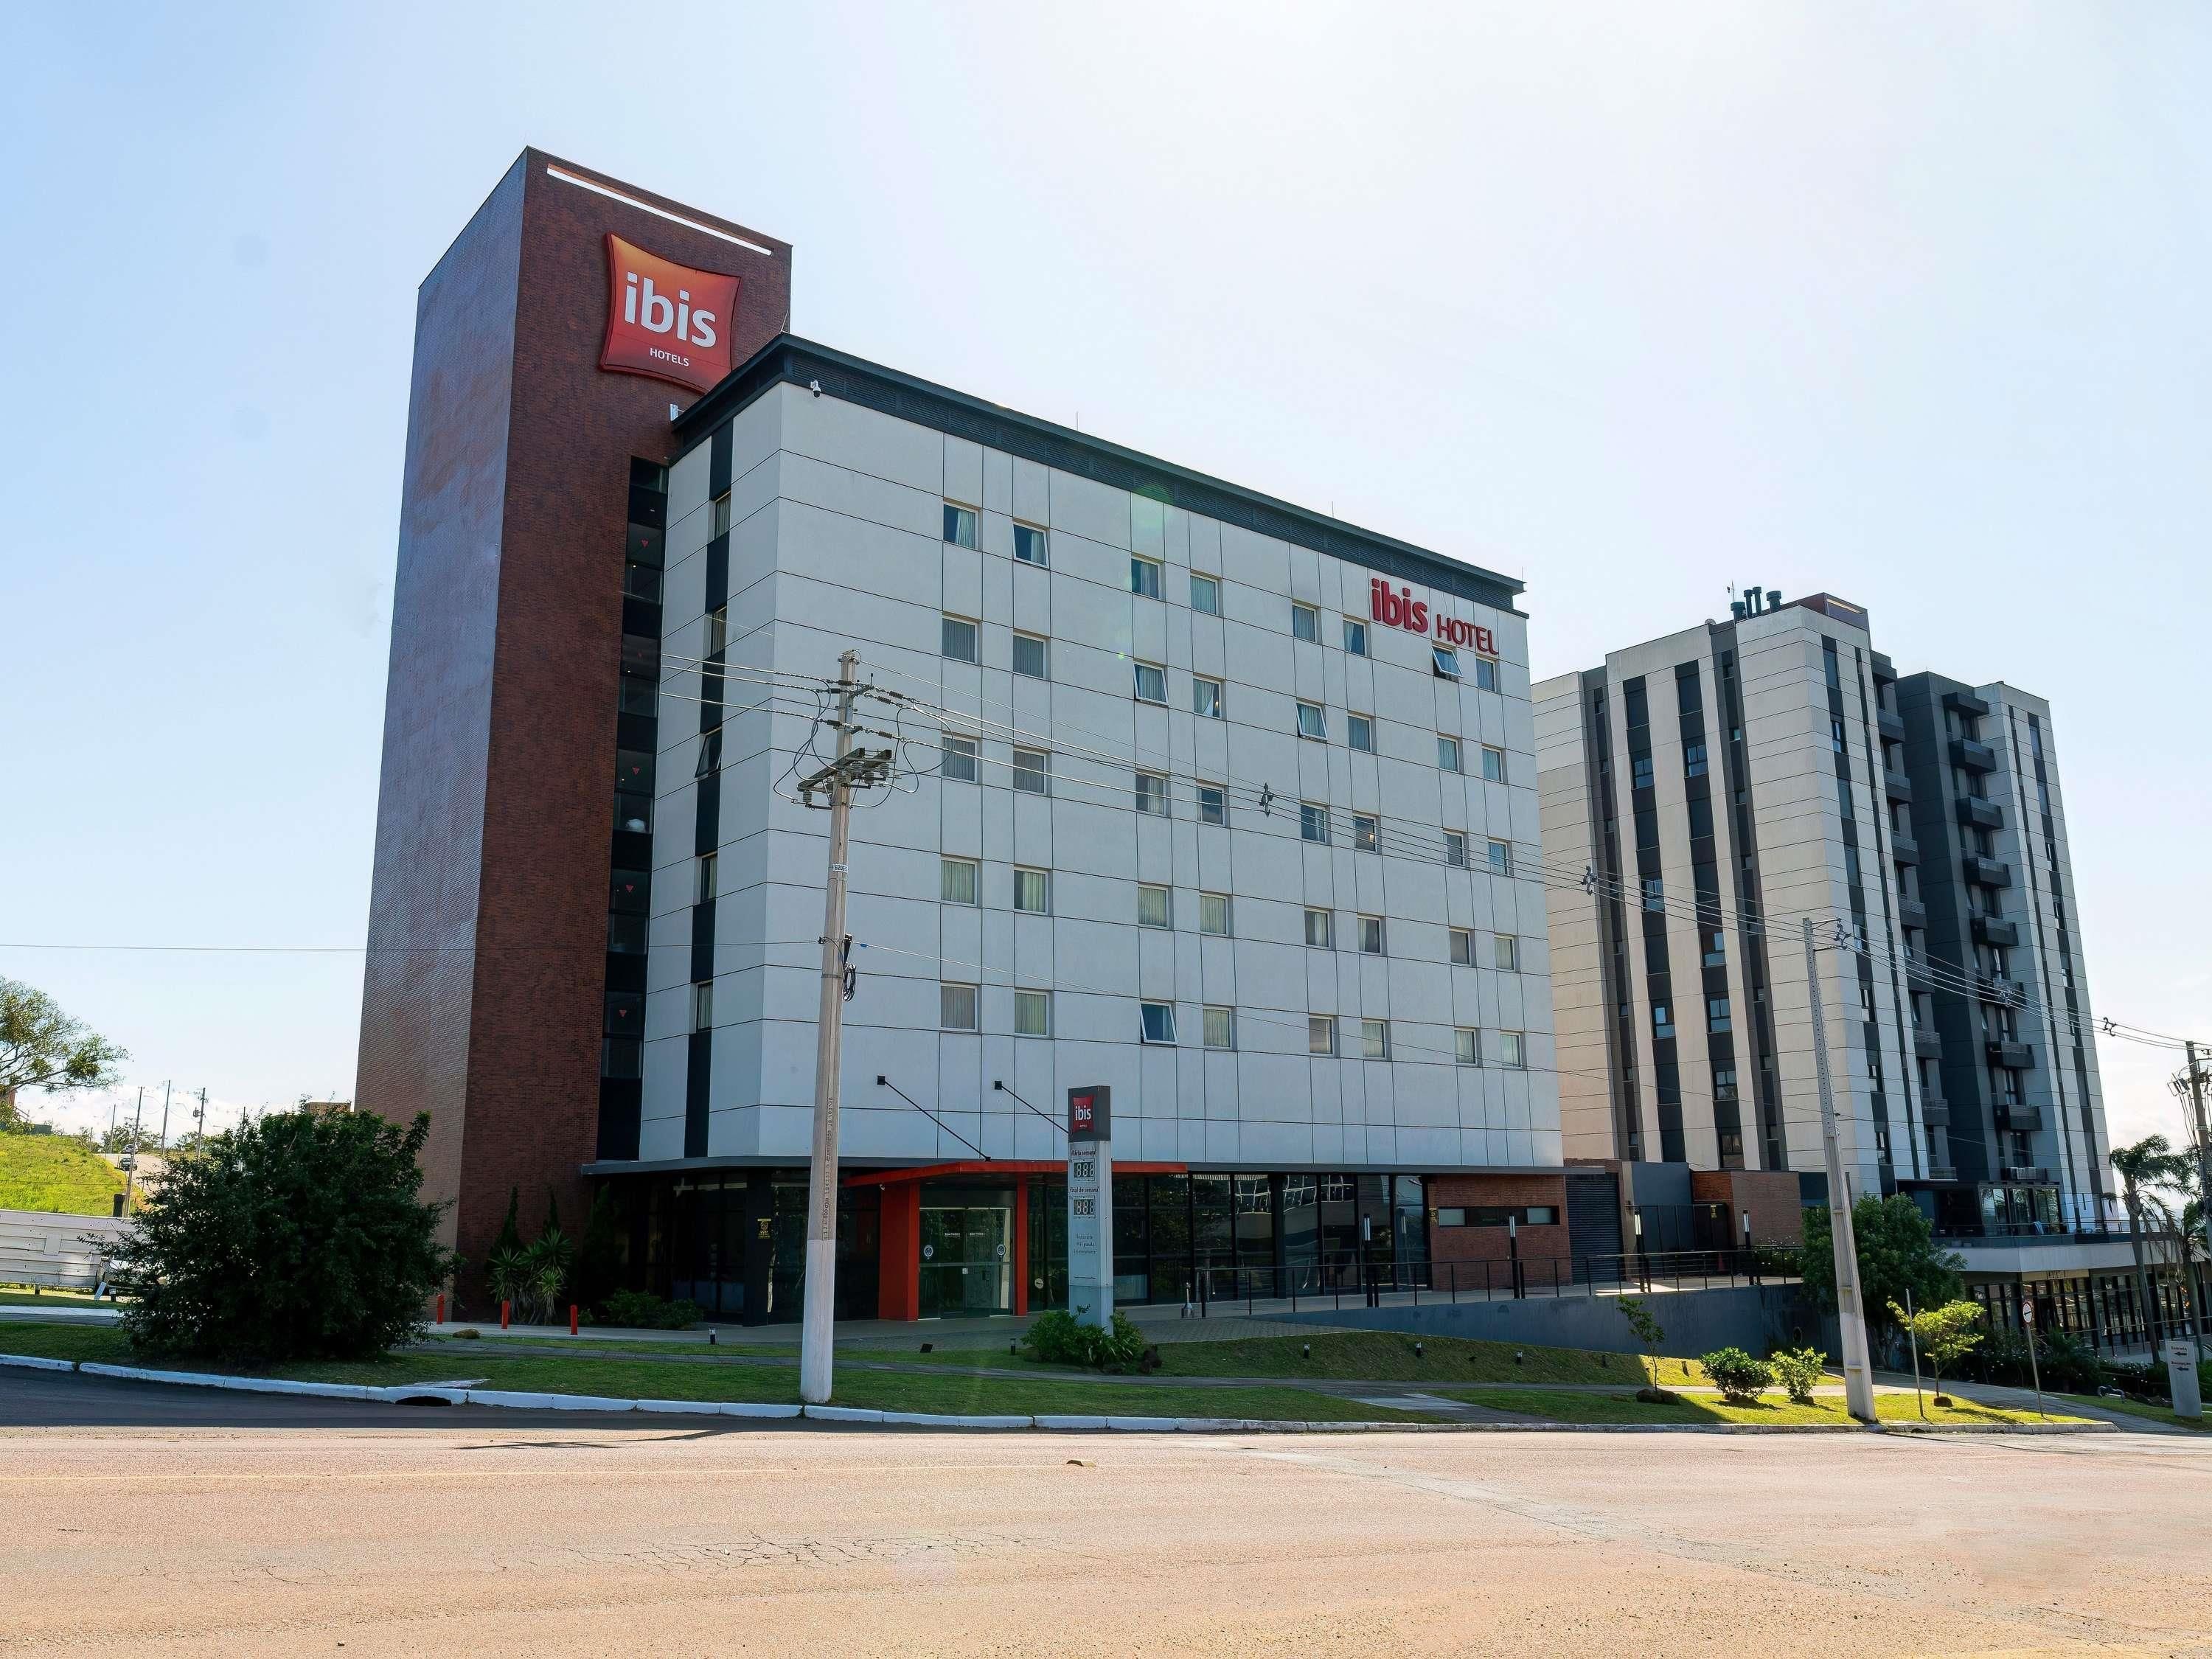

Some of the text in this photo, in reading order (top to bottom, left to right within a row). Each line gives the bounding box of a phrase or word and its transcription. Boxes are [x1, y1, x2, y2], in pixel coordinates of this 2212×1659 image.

[625, 271, 717, 348] ibis
[650, 347, 689, 366] HOTELS
[1371, 577, 1499, 655] ibis HOTEL
[1075, 1105, 1091, 1121] ibis
